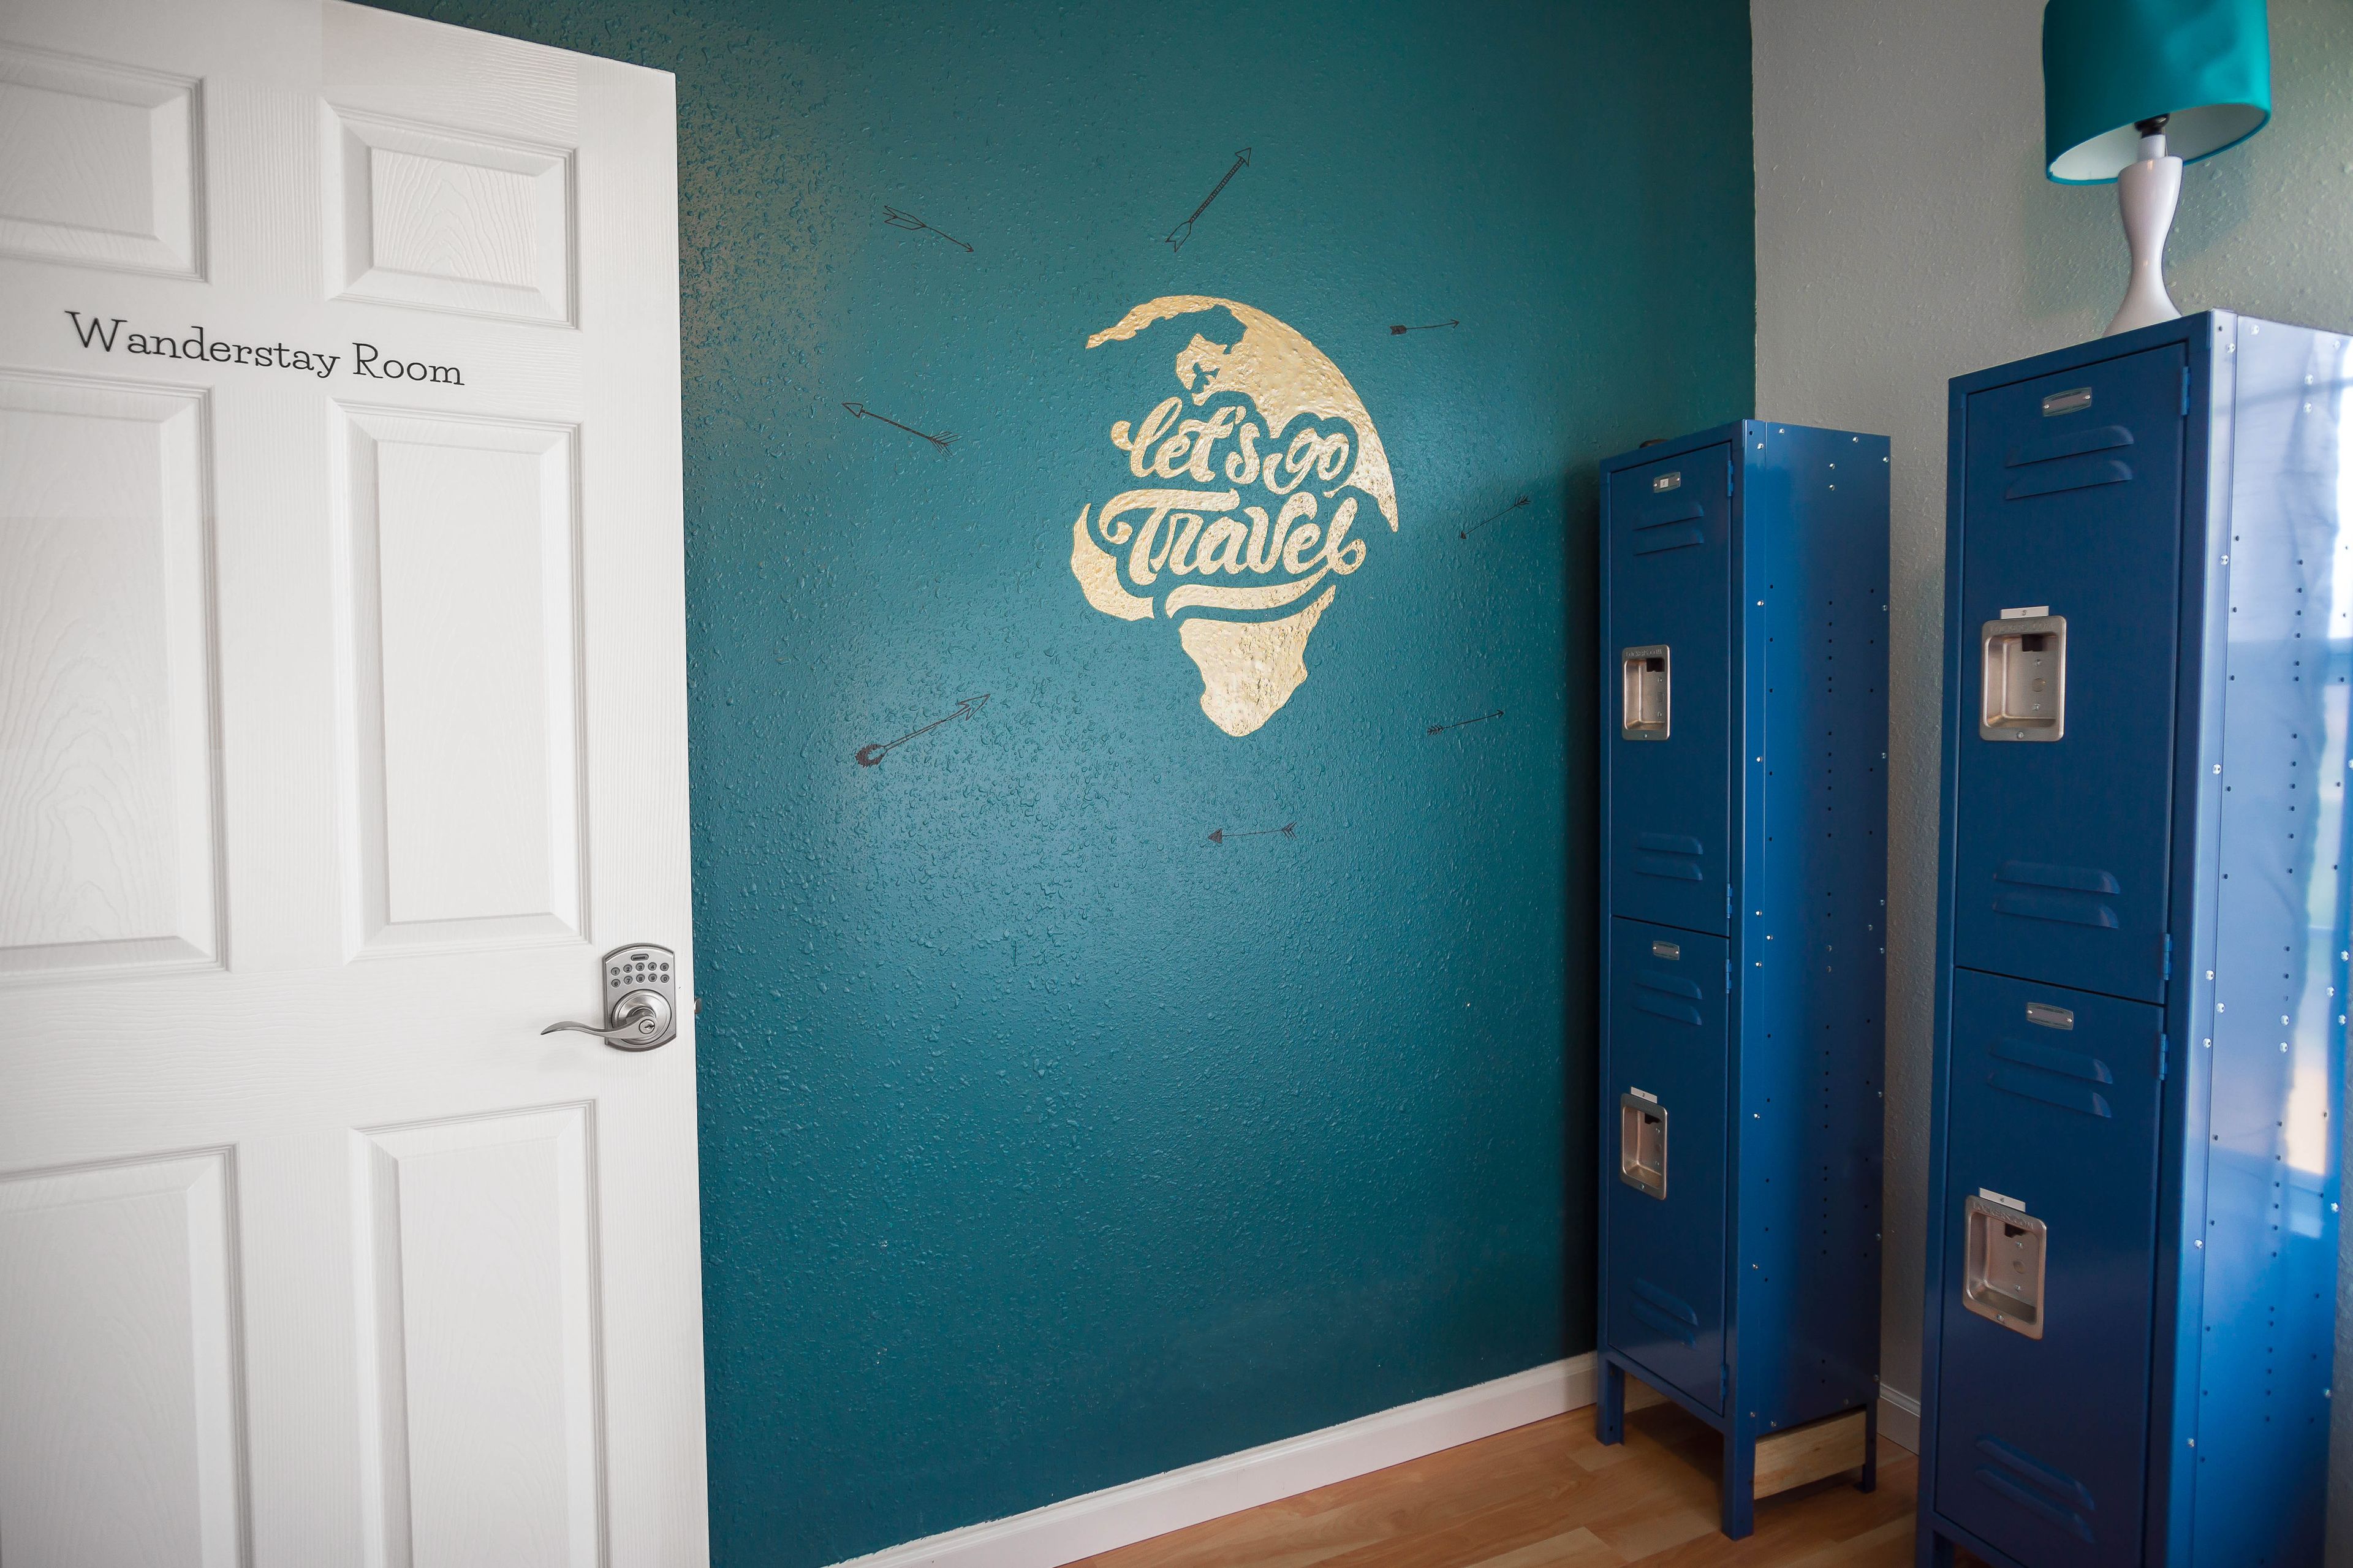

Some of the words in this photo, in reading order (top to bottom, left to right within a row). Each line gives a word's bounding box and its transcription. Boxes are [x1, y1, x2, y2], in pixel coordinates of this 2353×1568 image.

[64, 310, 341, 379] Wanderstay
[352, 342, 465, 386] Room
[1263, 428, 1349, 494] go
[1099, 488, 1366, 586] Travel
